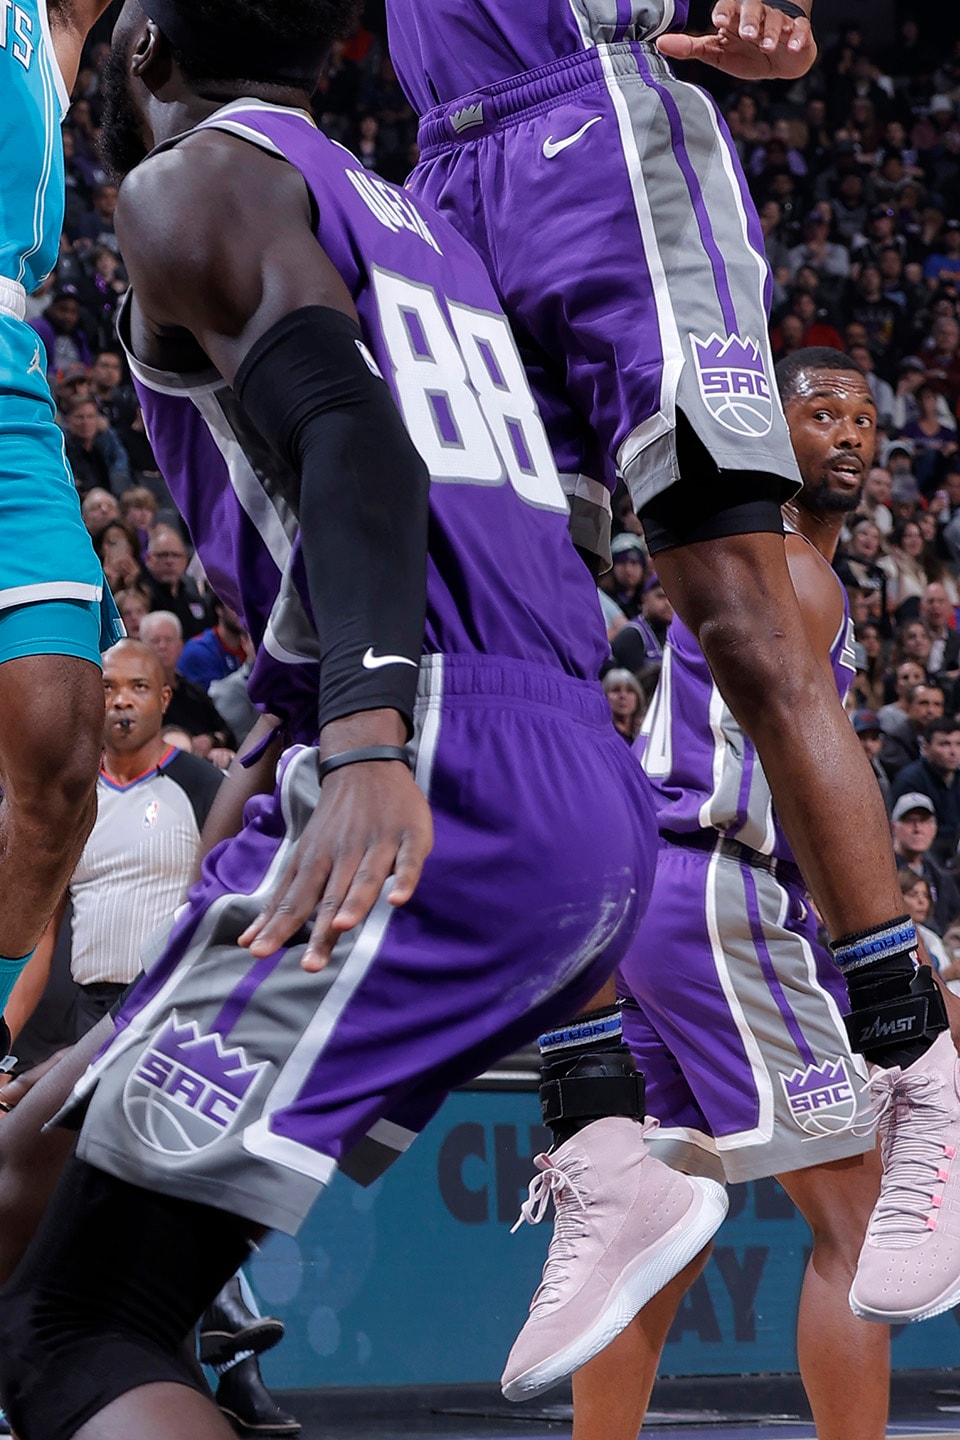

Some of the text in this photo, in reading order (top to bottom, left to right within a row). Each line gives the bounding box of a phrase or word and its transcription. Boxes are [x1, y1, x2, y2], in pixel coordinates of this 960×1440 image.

[370, 261, 572, 516] 88
[700, 370, 772, 401] SAC
[135, 1053, 239, 1128] SAC
[790, 1083, 853, 1113] SAC
